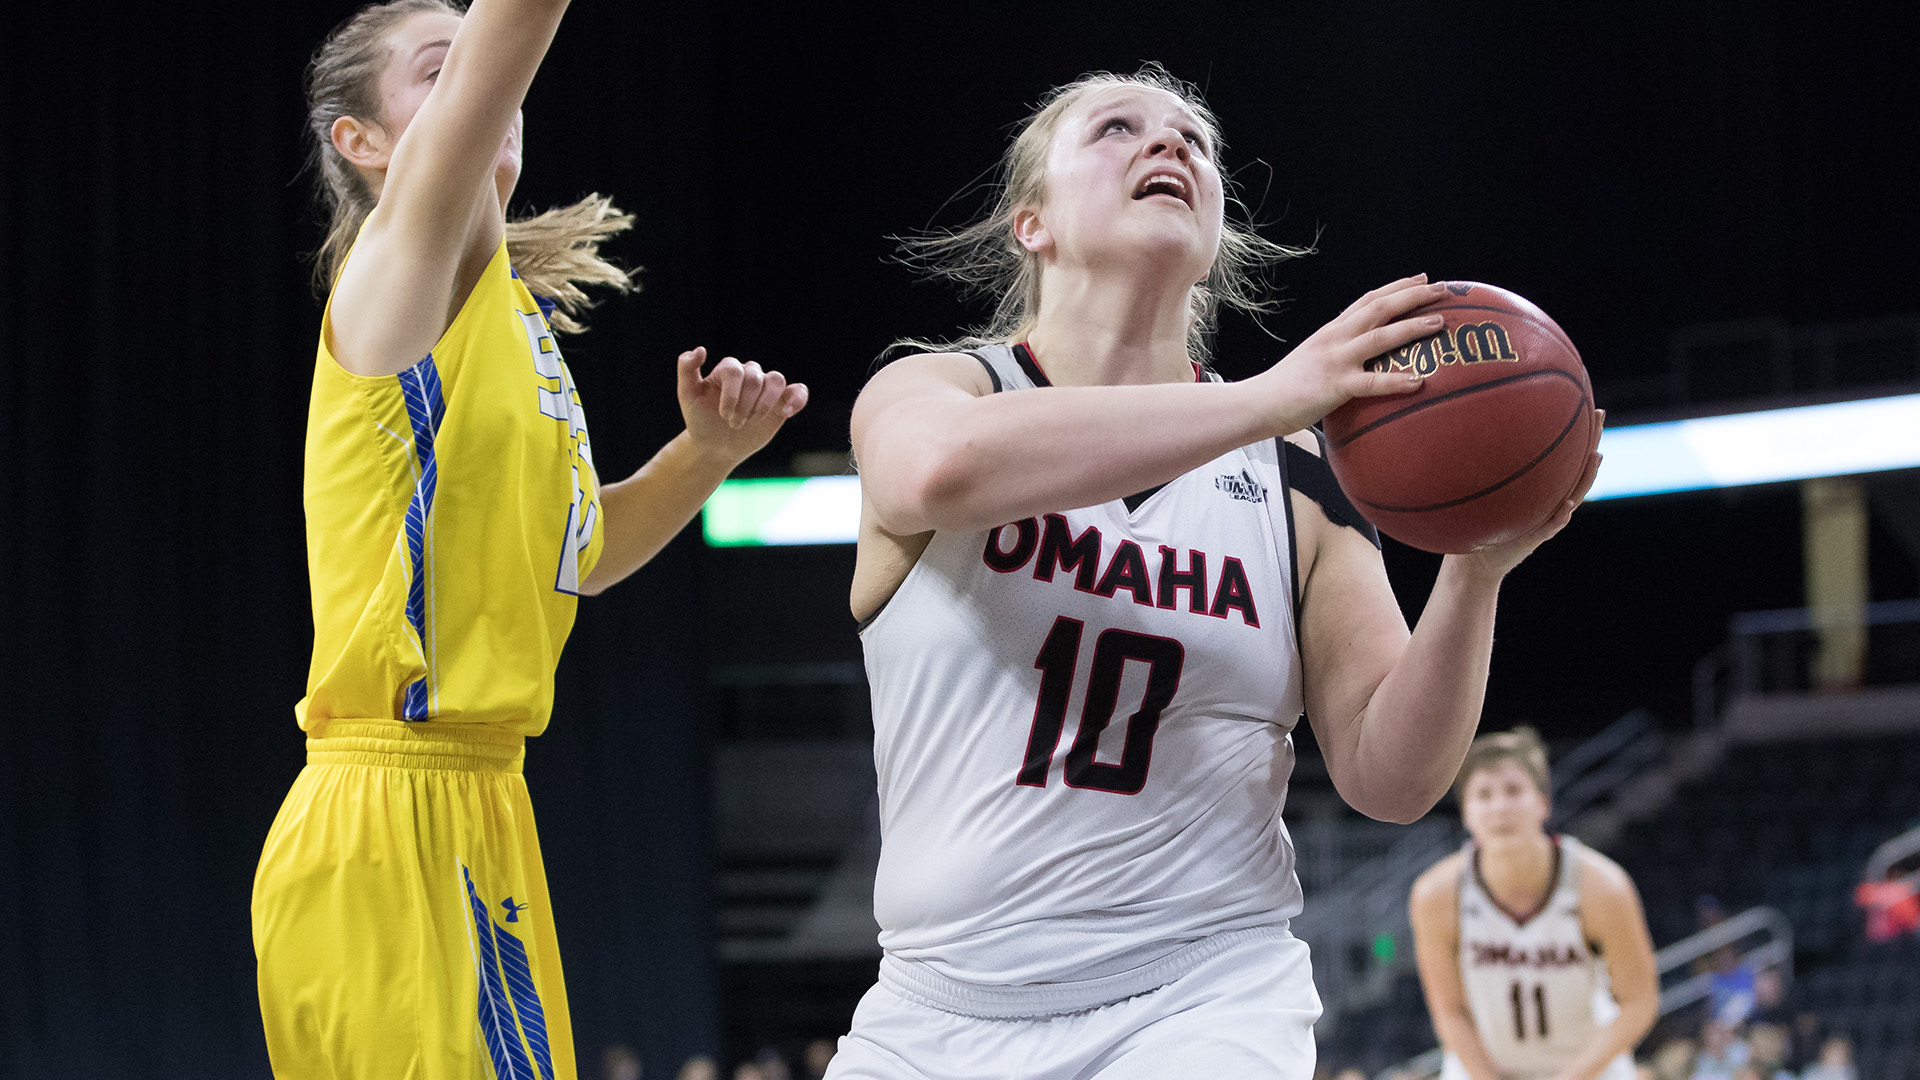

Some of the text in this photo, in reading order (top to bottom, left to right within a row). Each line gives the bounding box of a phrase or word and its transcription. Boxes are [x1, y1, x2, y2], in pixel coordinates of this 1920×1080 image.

[1363, 320, 1519, 379] Wil
[1229, 494, 1263, 503] LEAGUE
[983, 512, 1261, 630] OMAHA
[1016, 615, 1185, 796] 10
[1509, 979, 1550, 1042] 11
